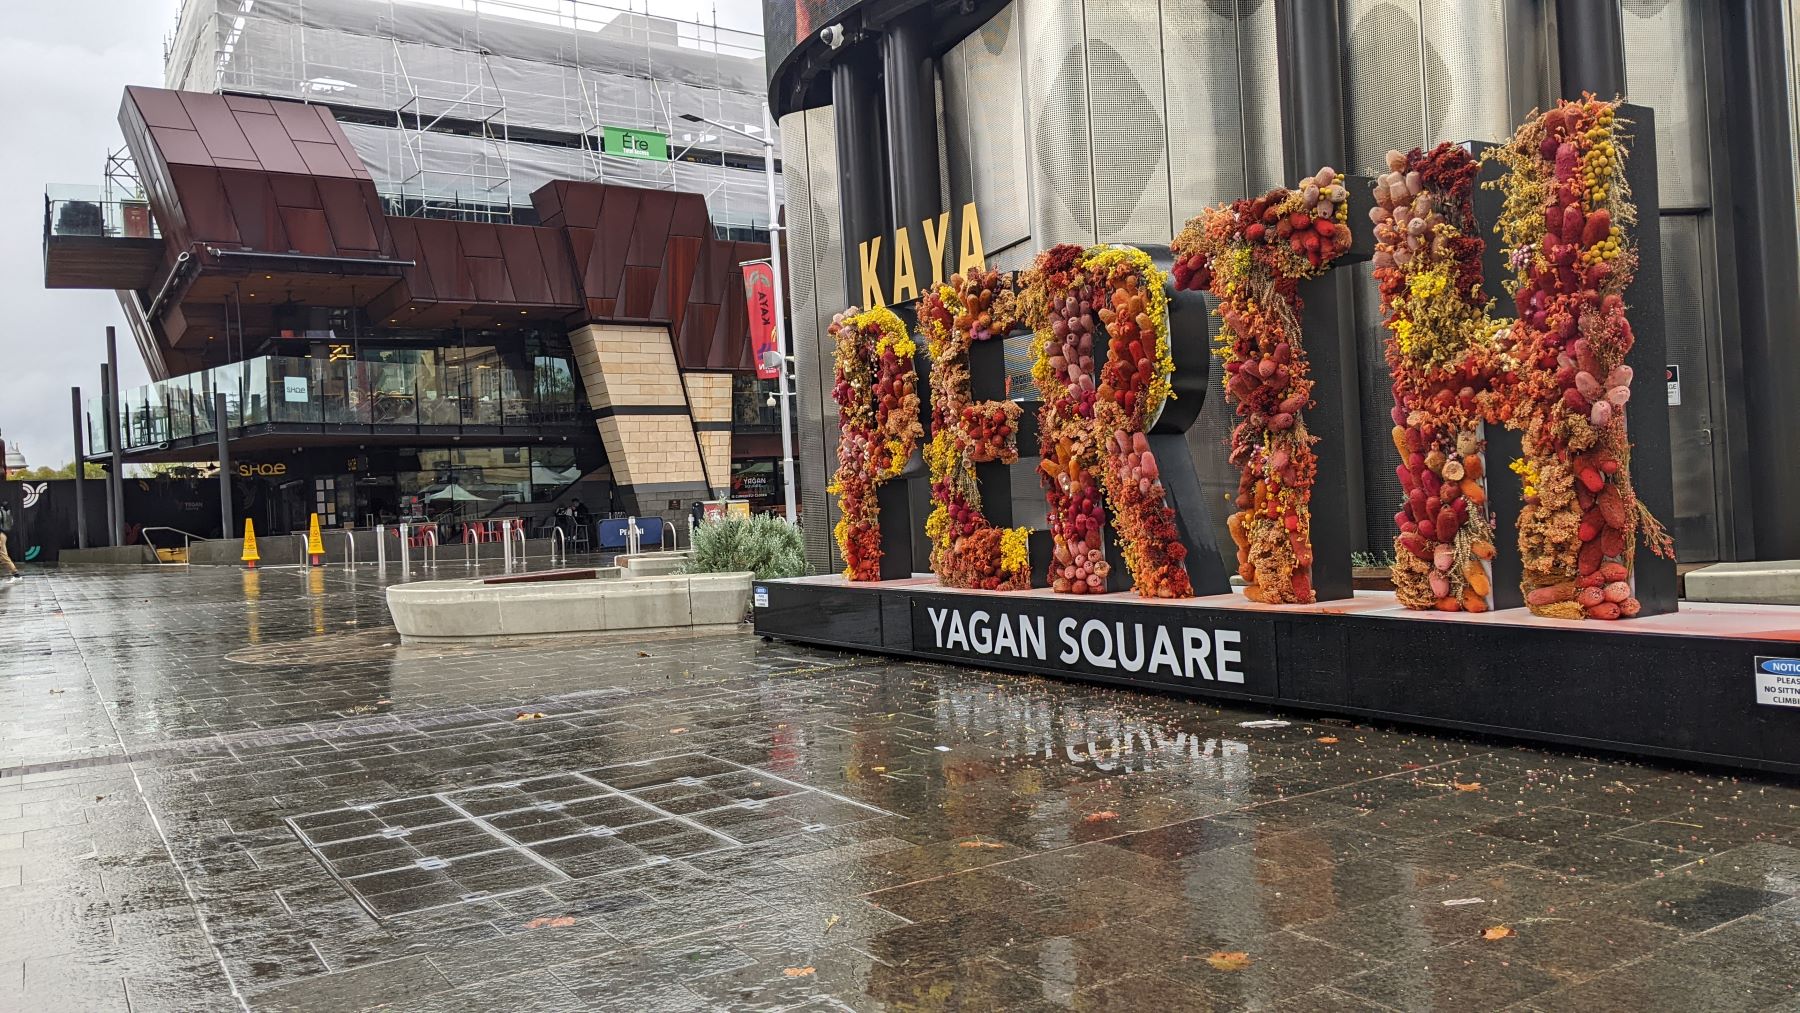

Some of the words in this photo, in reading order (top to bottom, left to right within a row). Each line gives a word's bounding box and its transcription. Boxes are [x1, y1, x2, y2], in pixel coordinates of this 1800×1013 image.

[859, 202, 986, 311] KAYA
[828, 92, 1672, 620] PERTH
[928, 607, 1046, 661] YAGAN
[1058, 616, 1245, 685] SQUARE
